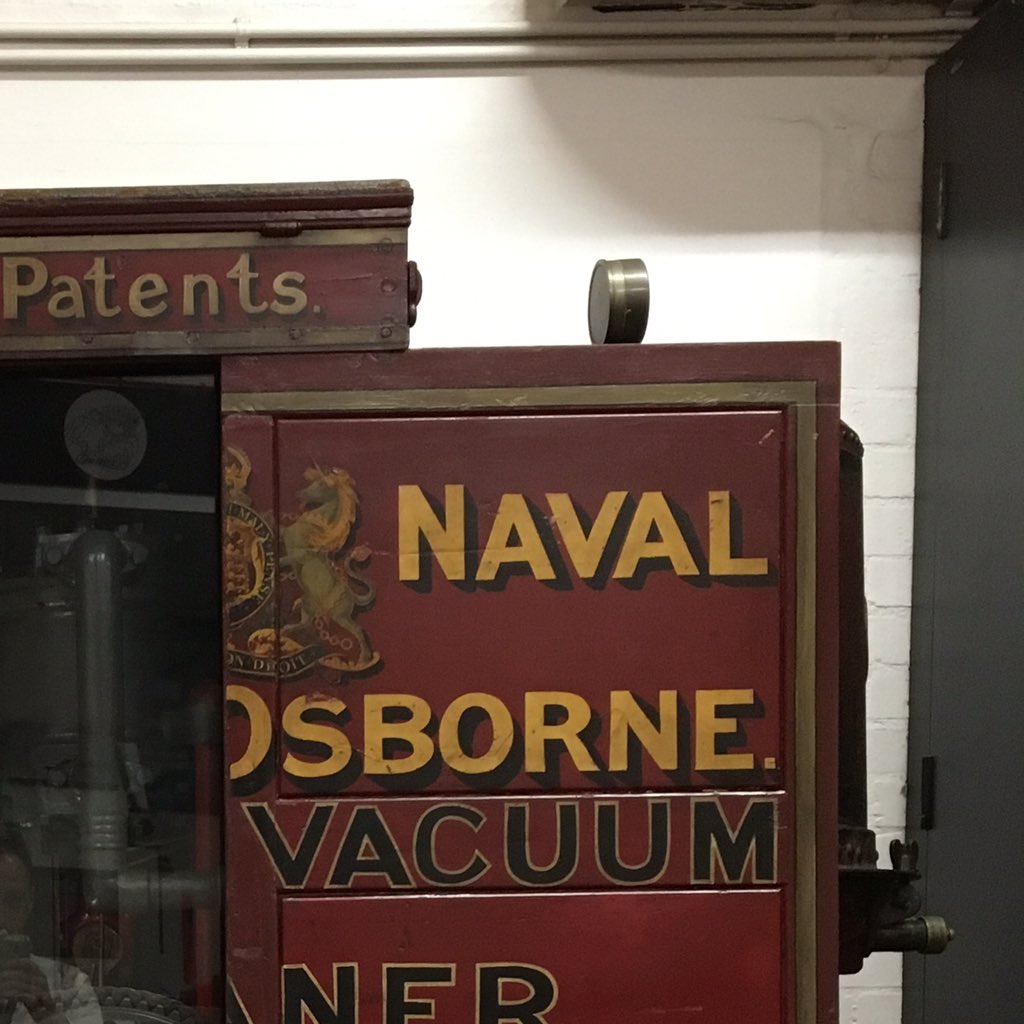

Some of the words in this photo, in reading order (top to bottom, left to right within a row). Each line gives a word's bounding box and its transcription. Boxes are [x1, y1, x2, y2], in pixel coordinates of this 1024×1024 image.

[2, 253, 322, 319] Patents.
[396, 484, 769, 581] NAVAL
[240, 797, 778, 890] VACUUM
